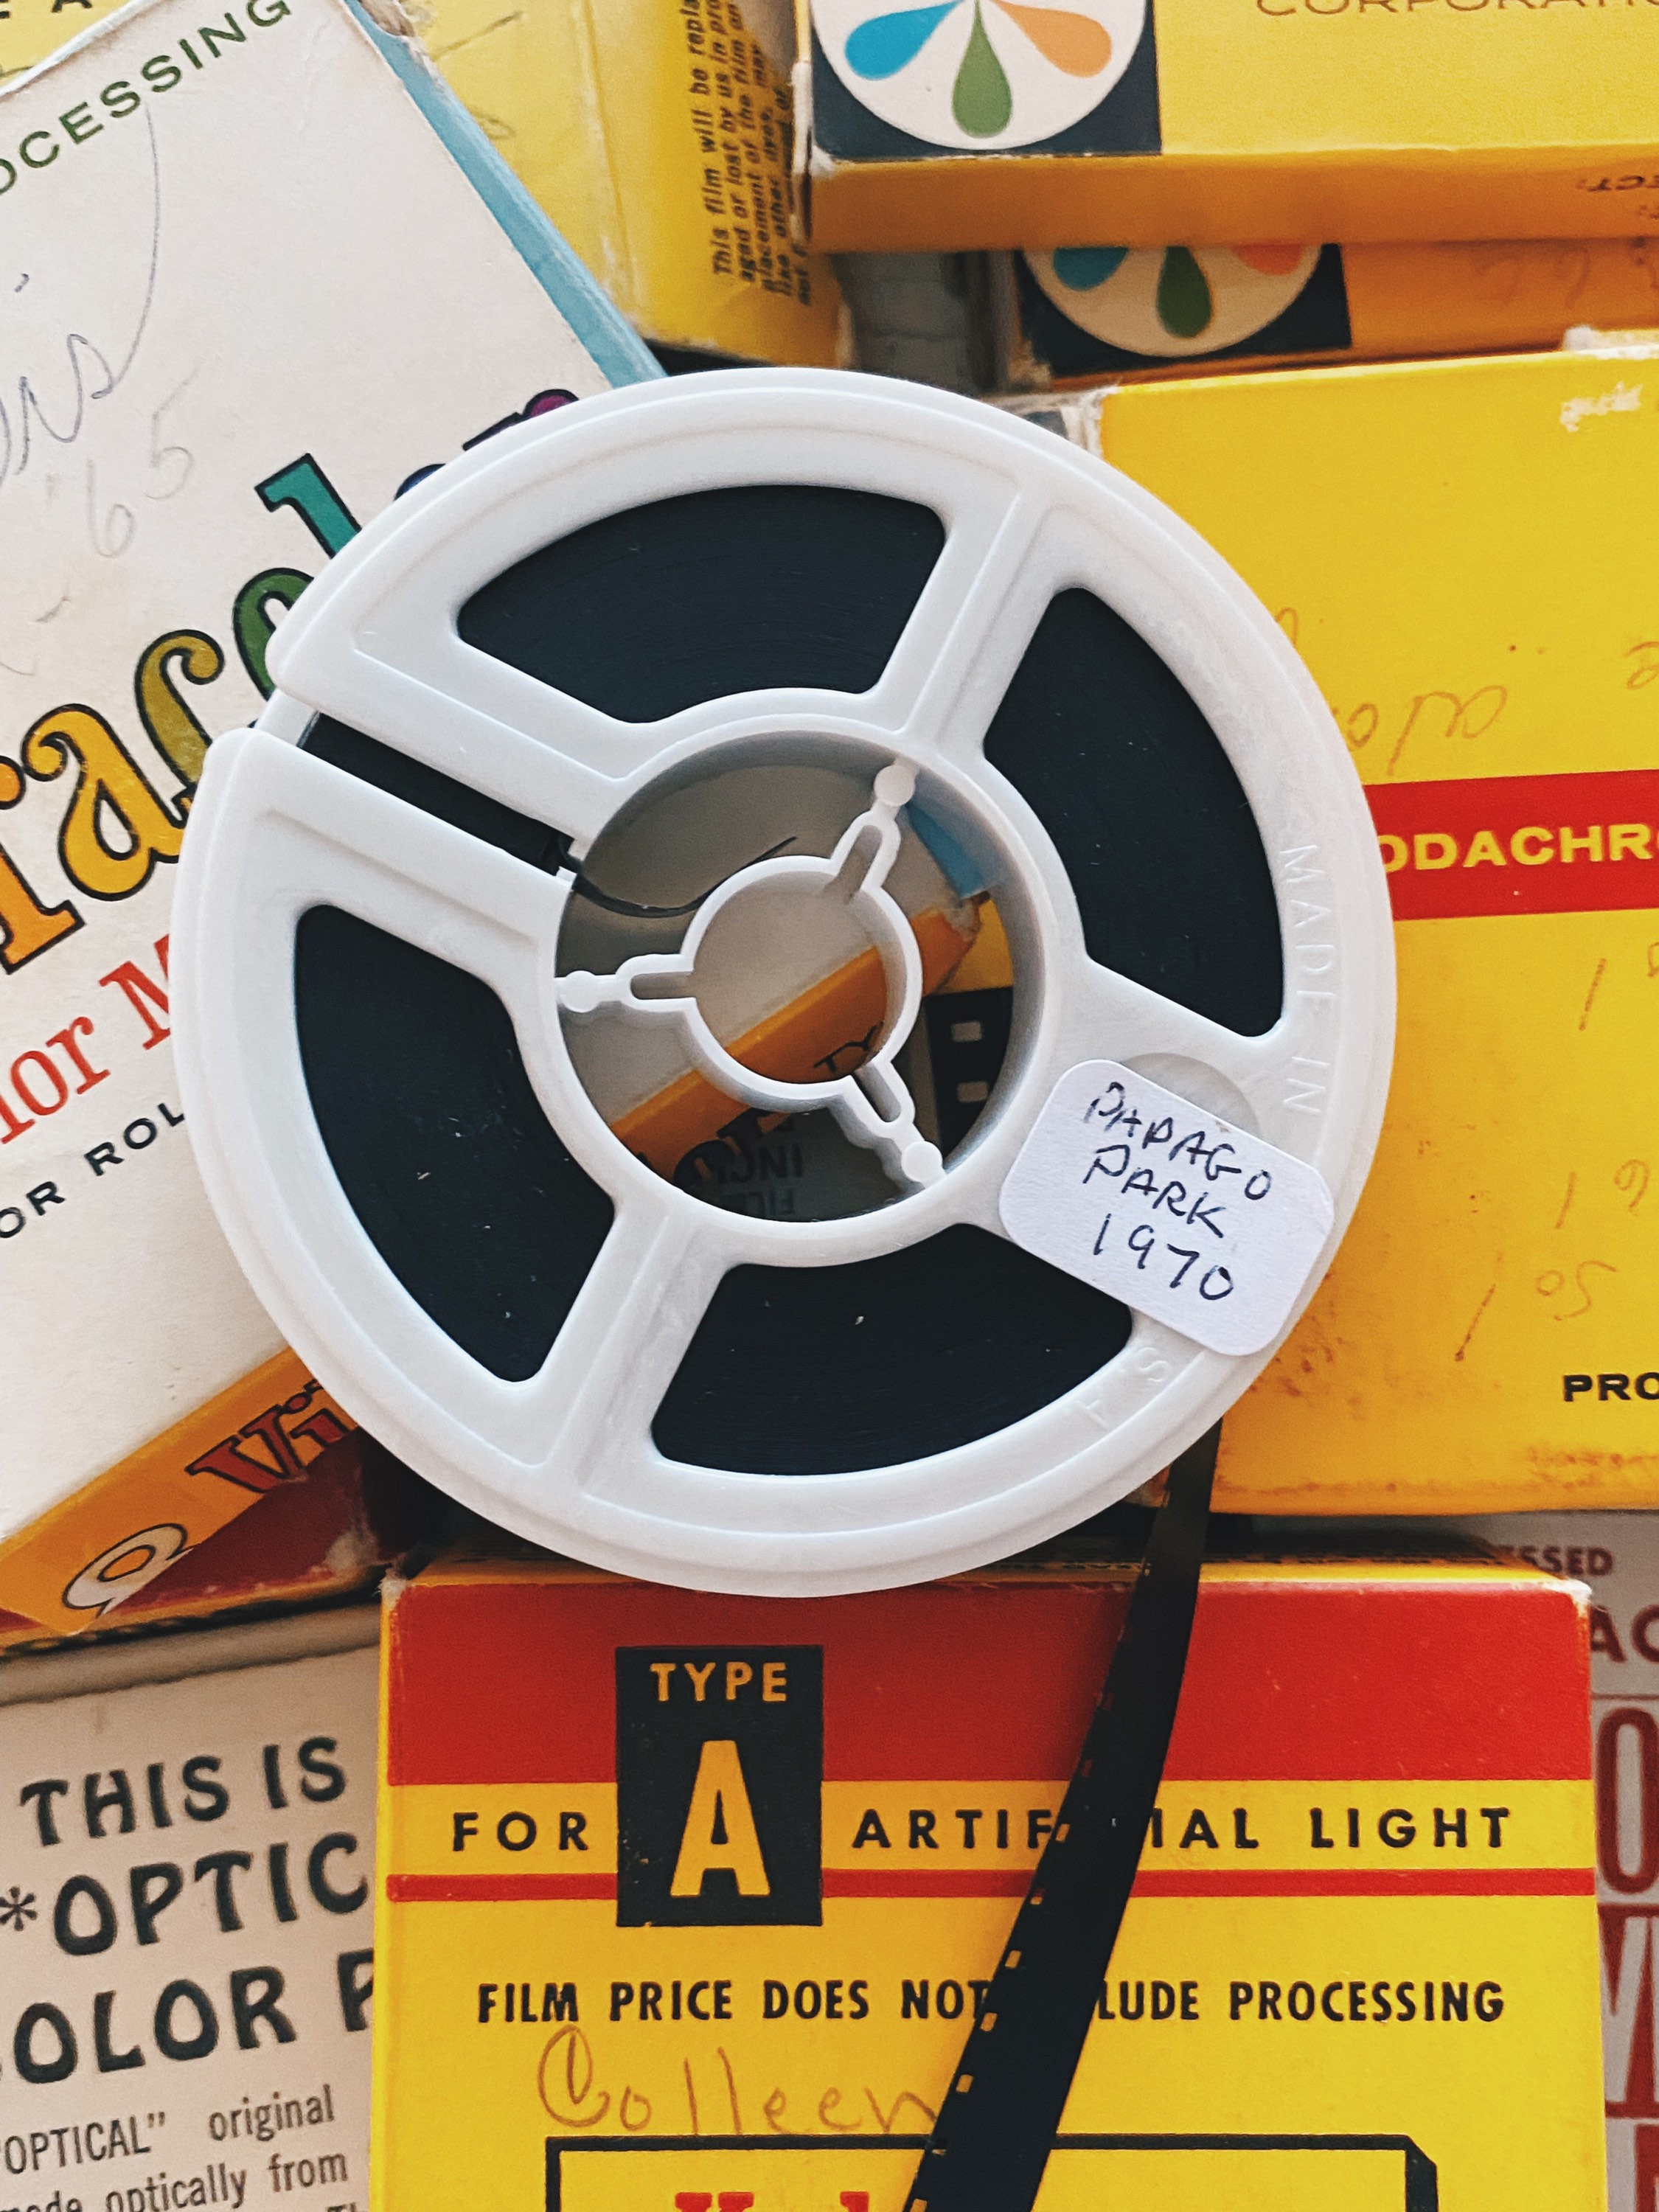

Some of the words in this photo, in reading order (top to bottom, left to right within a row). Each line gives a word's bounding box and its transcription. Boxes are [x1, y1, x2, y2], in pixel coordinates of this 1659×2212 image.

[689, 68, 711, 96] be
[691, 108, 717, 153] will
[701, 167, 726, 215] film
[1378, 822, 1659, 873] ODACHR
[1084, 1081, 1273, 1200] PAPAGO
[1082, 1144, 1226, 1239] PARK
[1093, 1213, 1234, 1301] 1970
[1563, 1371, 1659, 1402] PRO
[650, 1662, 787, 1702] TYPE
[20, 1756, 229, 1846] THIS
[262, 1736, 347, 1810] IS
[451, 1811, 589, 1852] FOR
[852, 1808, 1259, 1850] ARTIFIAL
[1310, 1807, 1510, 1848] LIGHT
[669, 1739, 772, 1898] A
[0, 1966, 298, 2084] OLOR
[477, 1983, 579, 2023] FILM
[609, 1980, 733, 2022] PRICE
[762, 1979, 869, 2020] DOES
[1228, 1980, 1506, 2023] PROCESSING
[208, 2084, 335, 2142] original
[268, 2152, 349, 2193] from
